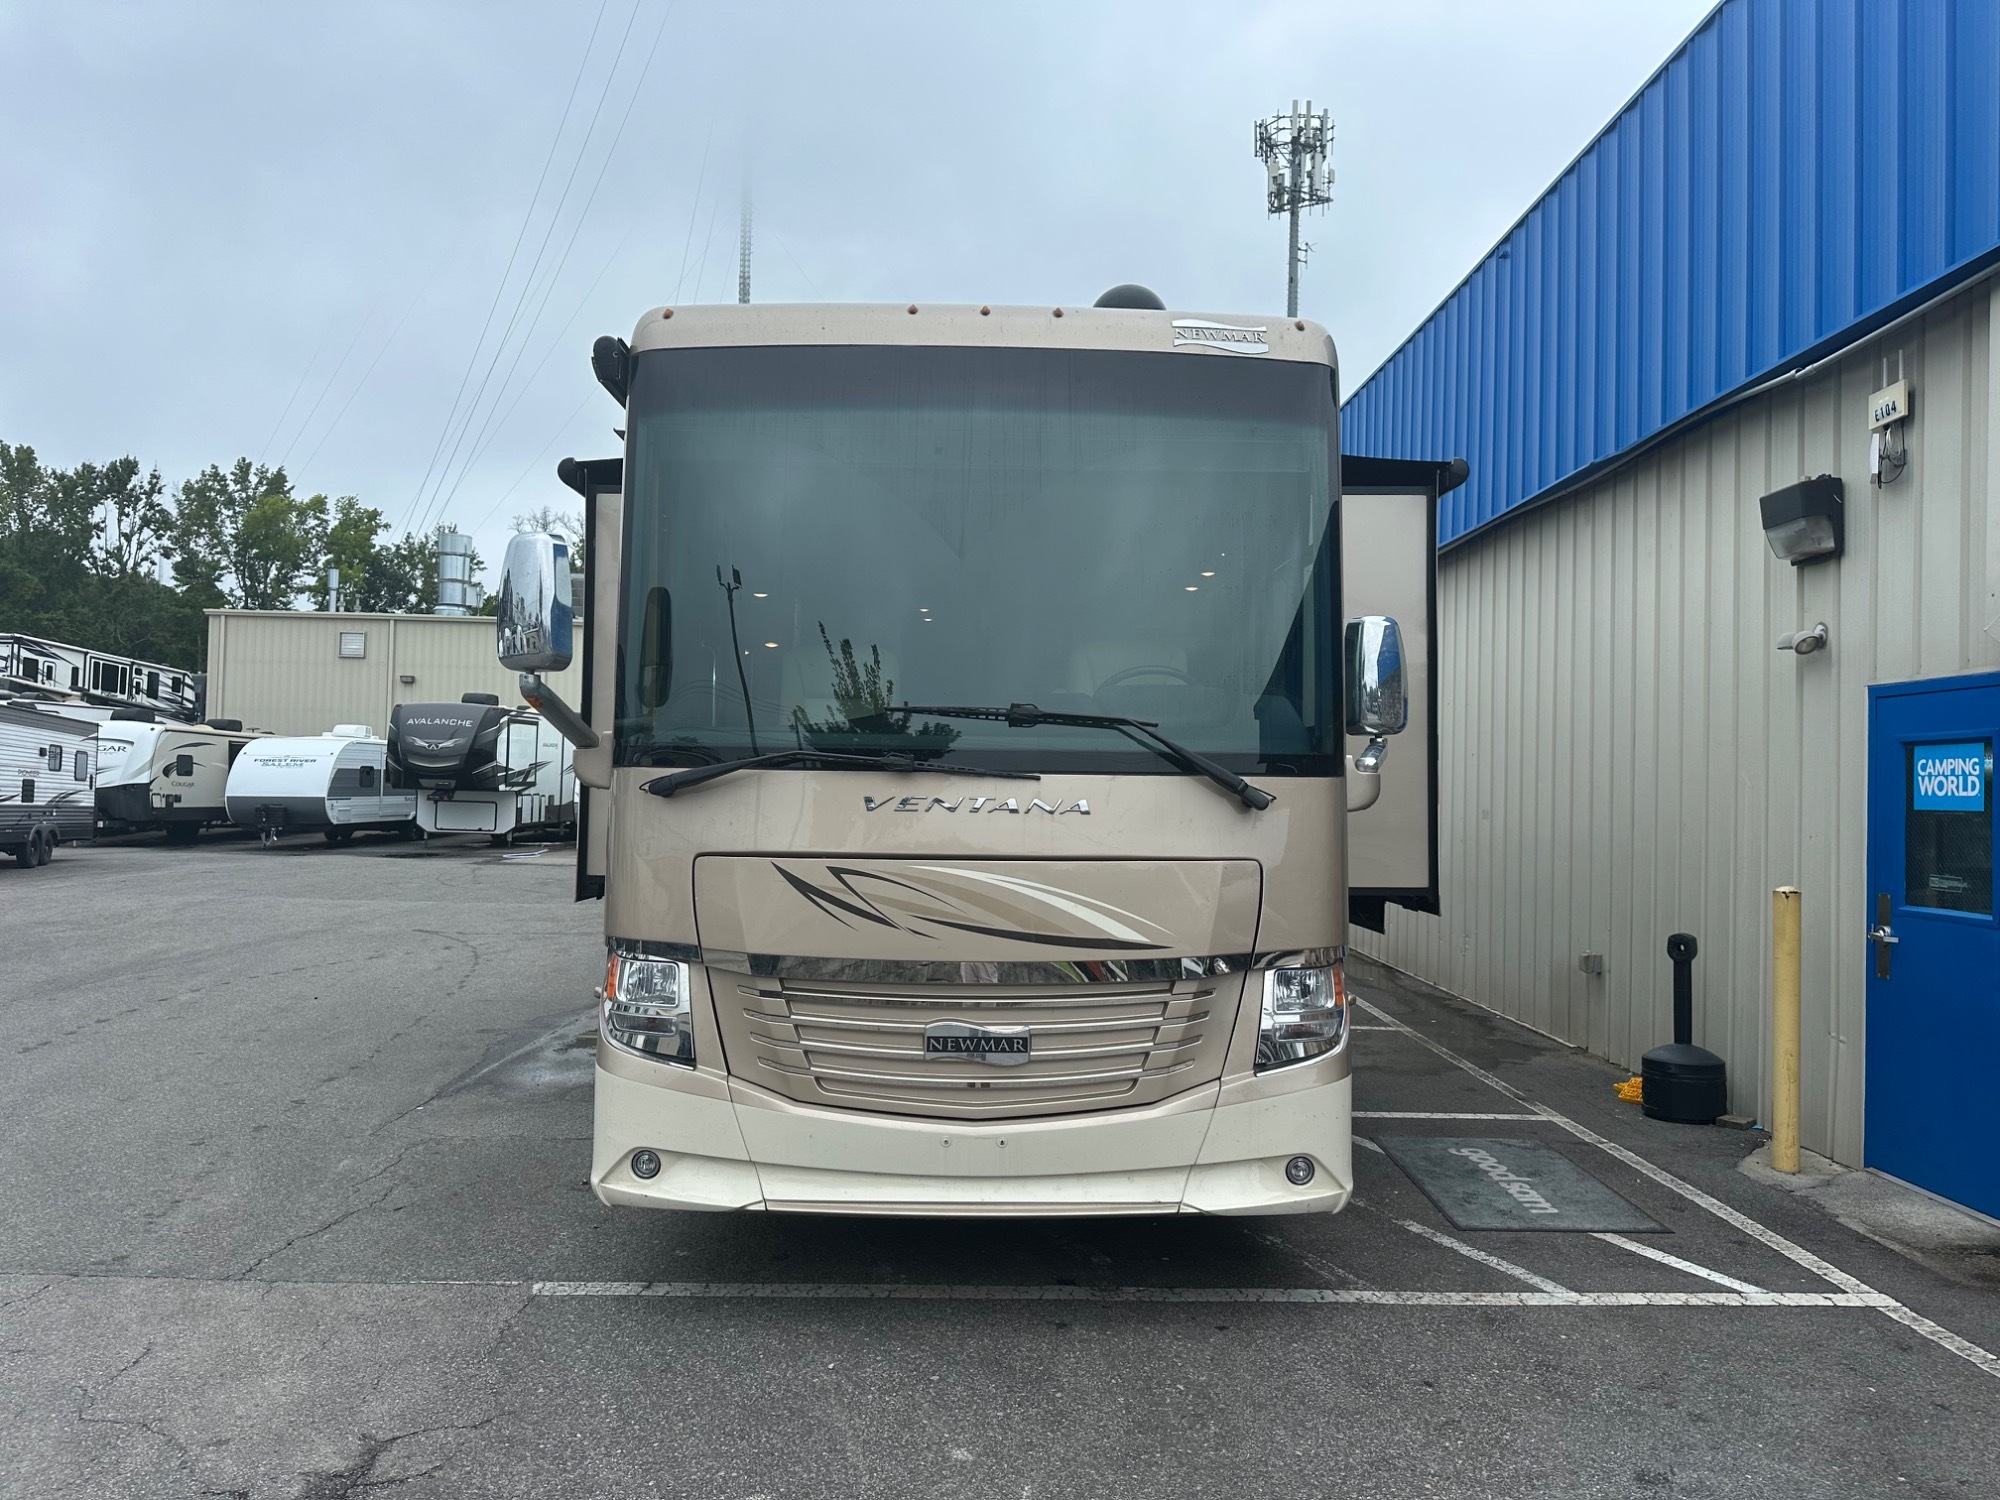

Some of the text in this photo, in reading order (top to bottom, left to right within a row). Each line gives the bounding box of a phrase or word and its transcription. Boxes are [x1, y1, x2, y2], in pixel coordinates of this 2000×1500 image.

[1174, 327, 1267, 344] NEWMAR
[1874, 400, 1897, 422] E104
[406, 717, 474, 728] AVALANCHE
[1917, 757, 1980, 776] CAMPING
[1917, 775, 1980, 797] WORLD
[863, 796, 1091, 815] VENTANA
[929, 1038, 1026, 1052] NEWMAR
